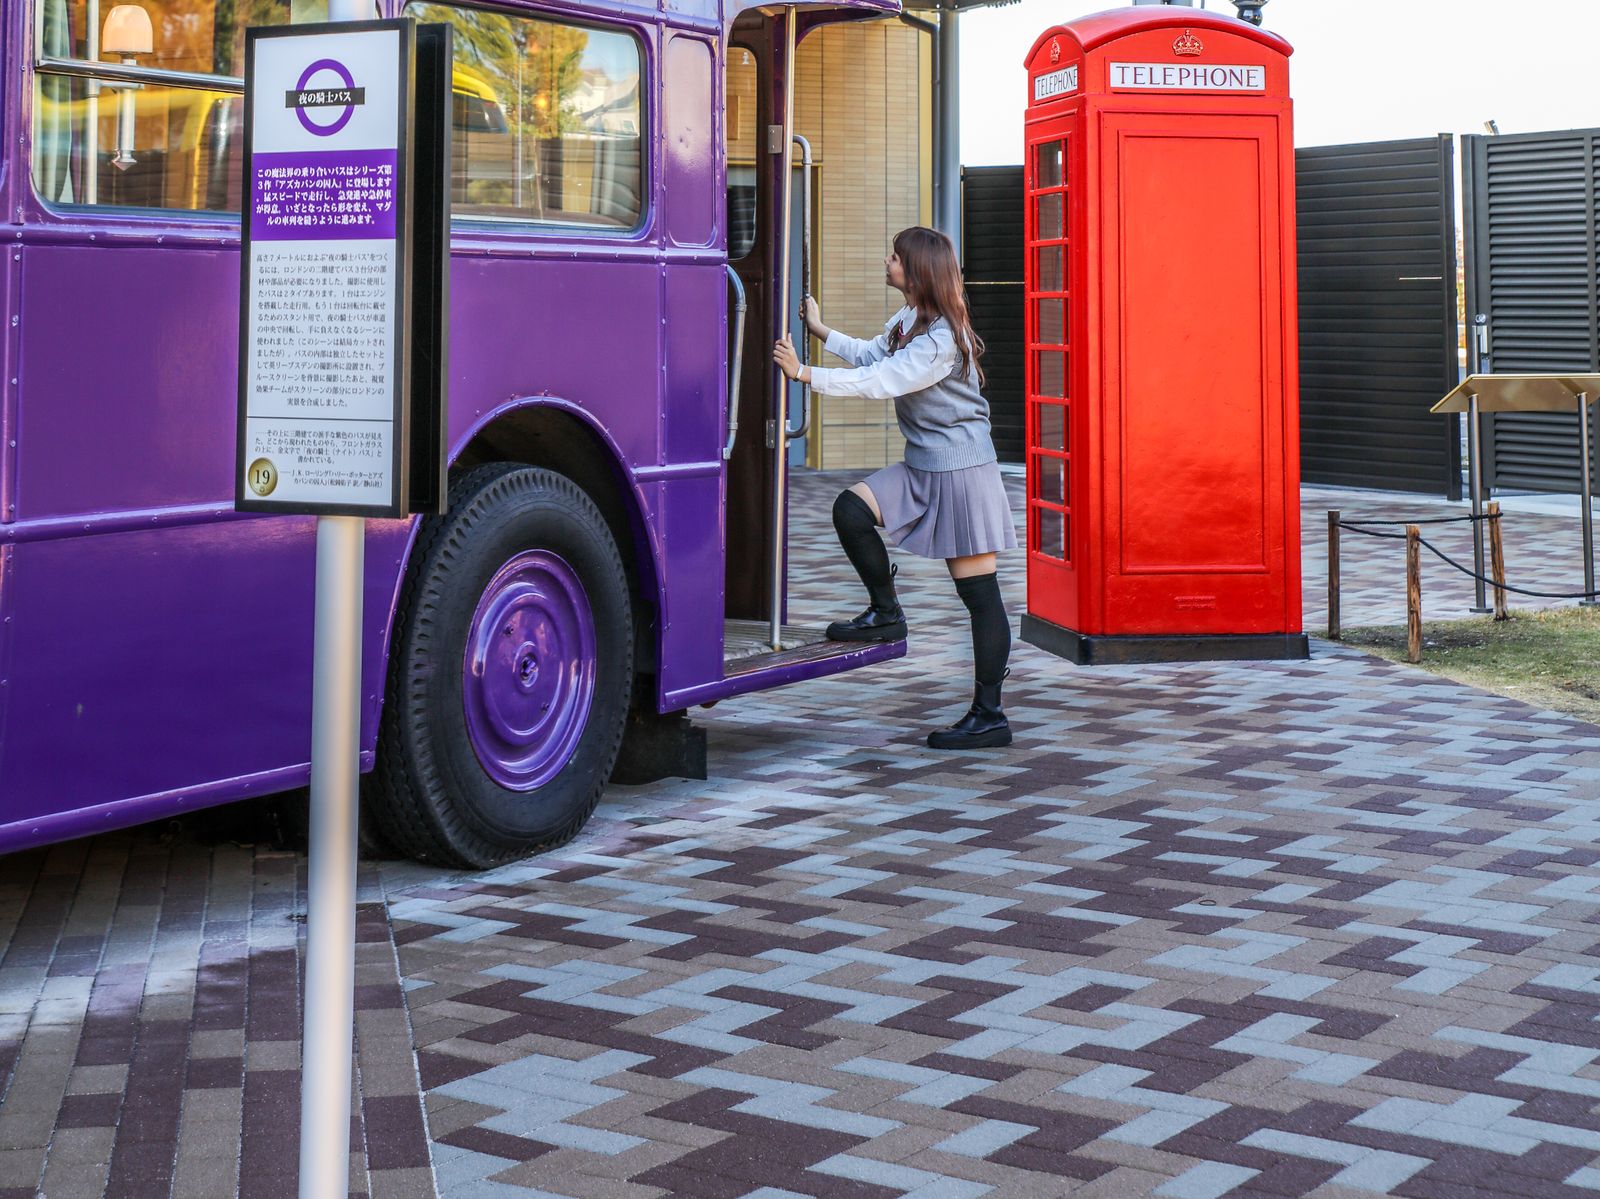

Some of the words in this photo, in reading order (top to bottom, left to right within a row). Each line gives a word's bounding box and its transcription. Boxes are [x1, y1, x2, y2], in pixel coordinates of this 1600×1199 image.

[1036, 68, 1078, 98] TELEPHONE
[1115, 65, 1259, 88] TELEPHONE
[298, 91, 352, 105] 夜の騎士バス
[255, 469, 271, 486] 19
